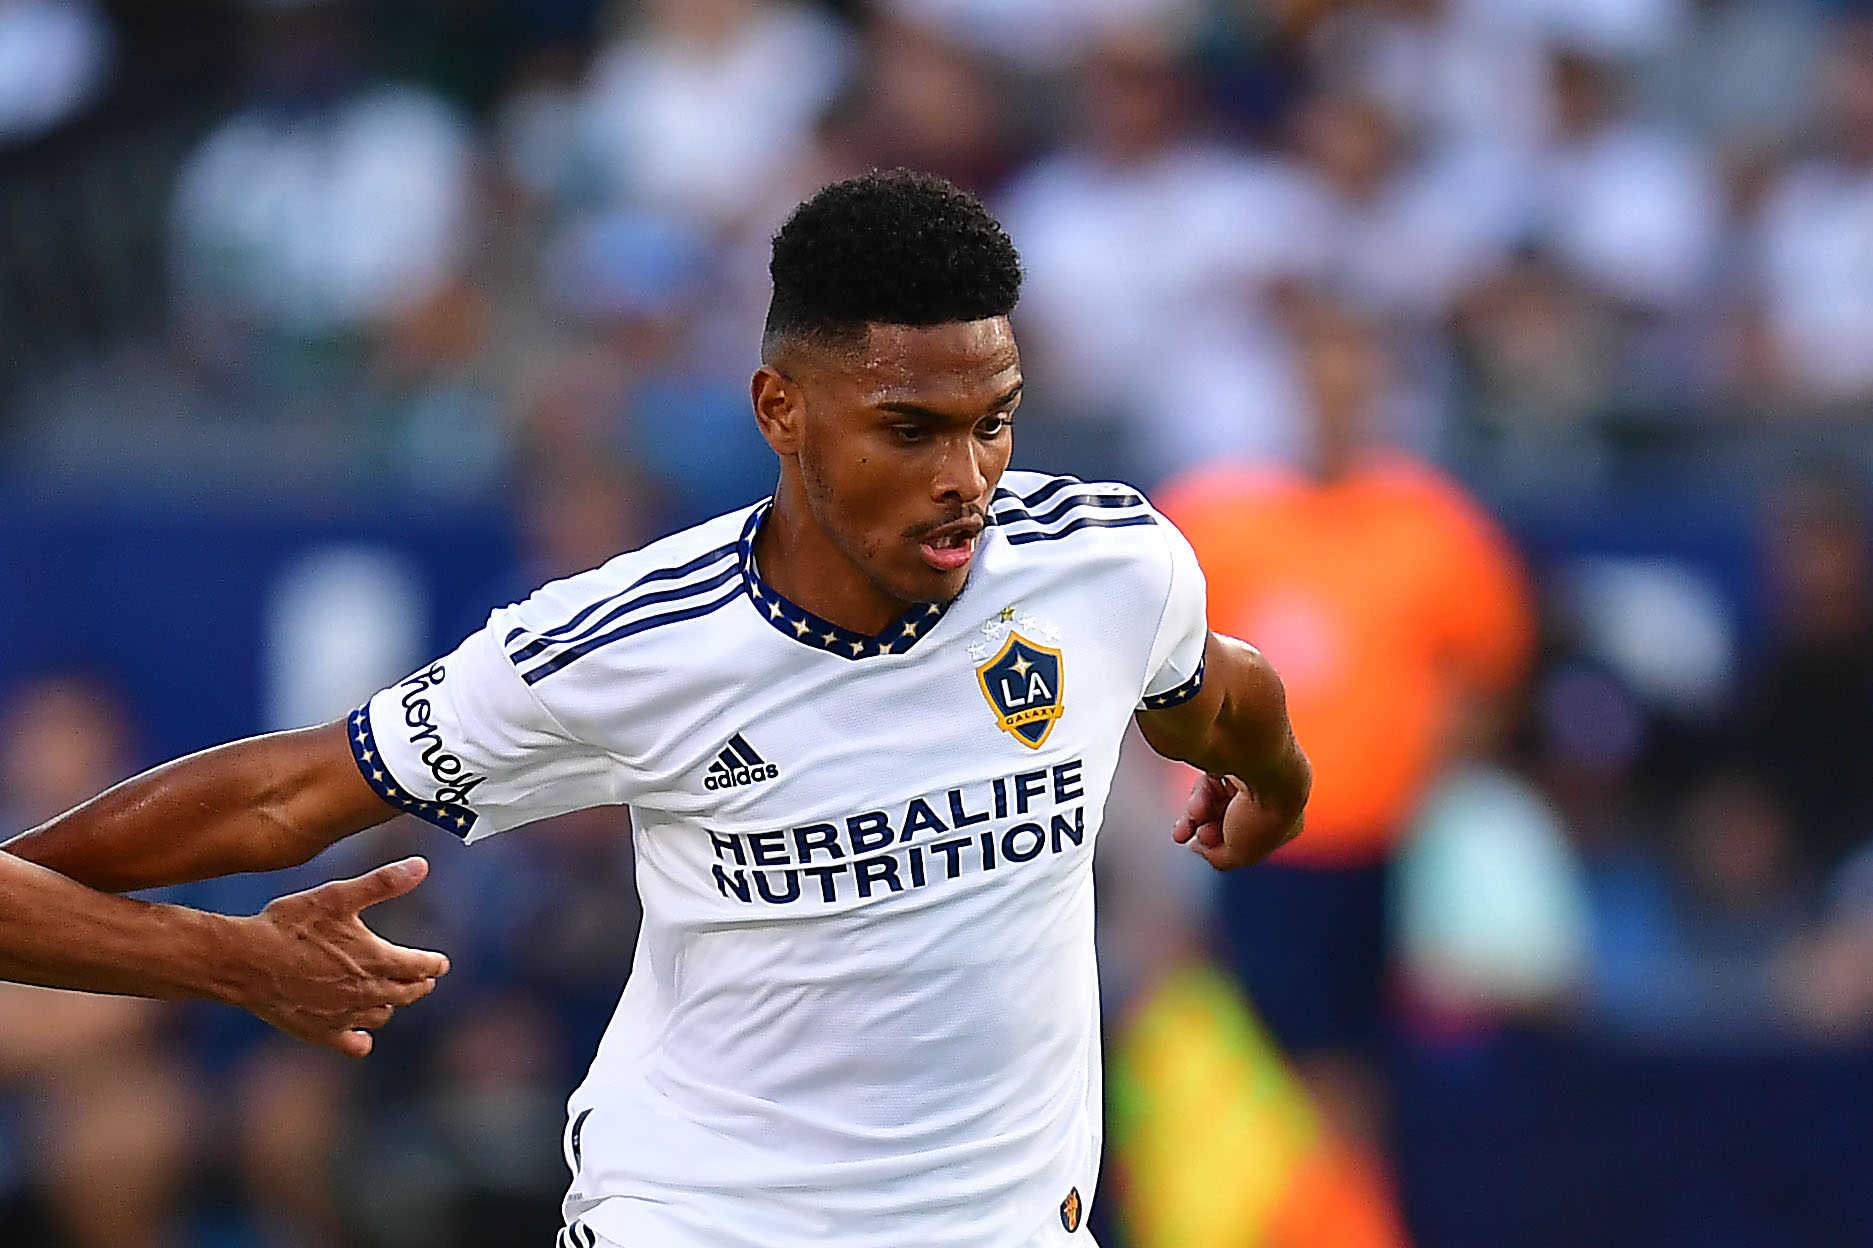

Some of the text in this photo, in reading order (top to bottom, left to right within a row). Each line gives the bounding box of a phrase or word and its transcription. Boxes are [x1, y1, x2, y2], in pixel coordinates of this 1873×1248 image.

[1000, 671, 1053, 708] LA
[1006, 707, 1056, 725] GALAXY
[704, 764, 779, 791] adidas
[707, 758, 1085, 867] HERBALIFE
[712, 806, 1085, 904] NUTRITION
